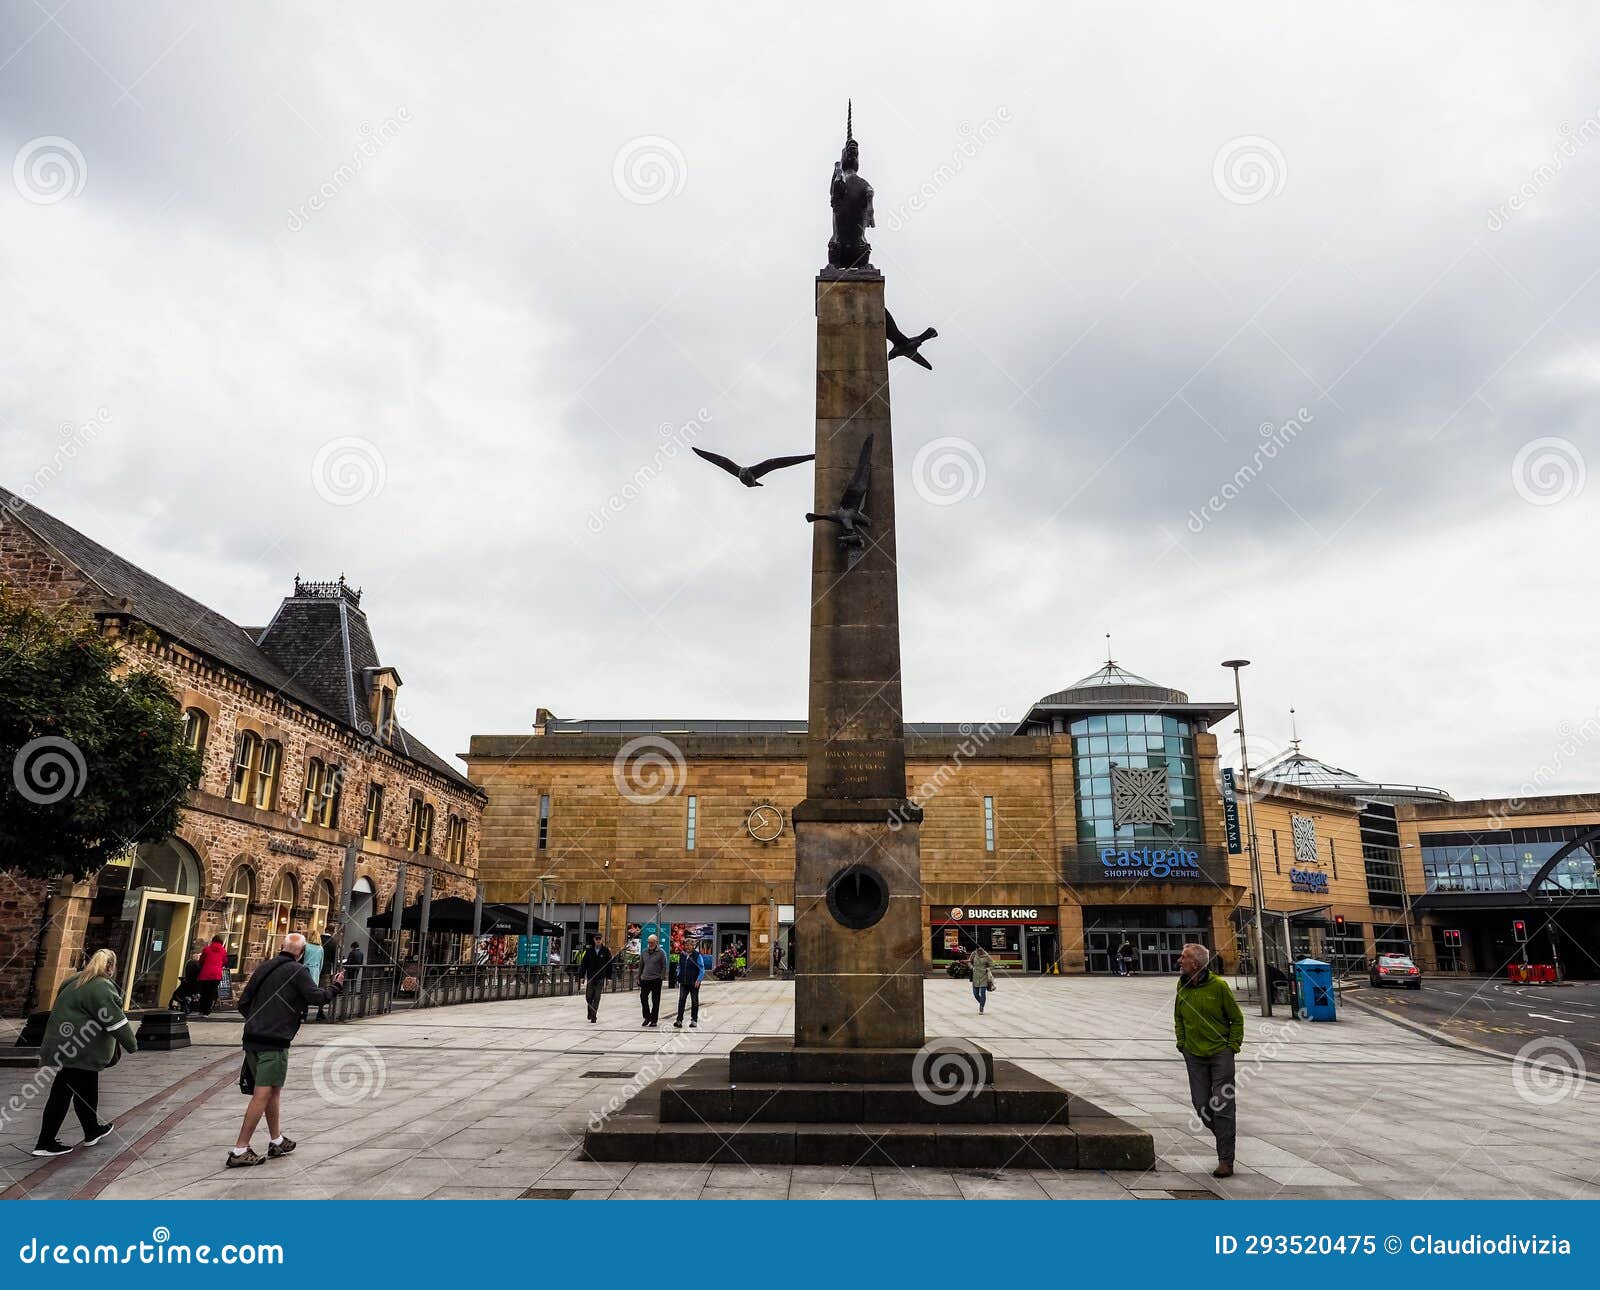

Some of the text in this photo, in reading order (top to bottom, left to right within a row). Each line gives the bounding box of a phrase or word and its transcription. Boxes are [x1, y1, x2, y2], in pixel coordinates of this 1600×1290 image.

[1223, 773, 1238, 849] DEBENHAMS
[1101, 846, 1198, 878] eastgate
[1104, 870, 1200, 878] SHOPPING CENTRE
[968, 909, 1038, 919] BURGER KING
